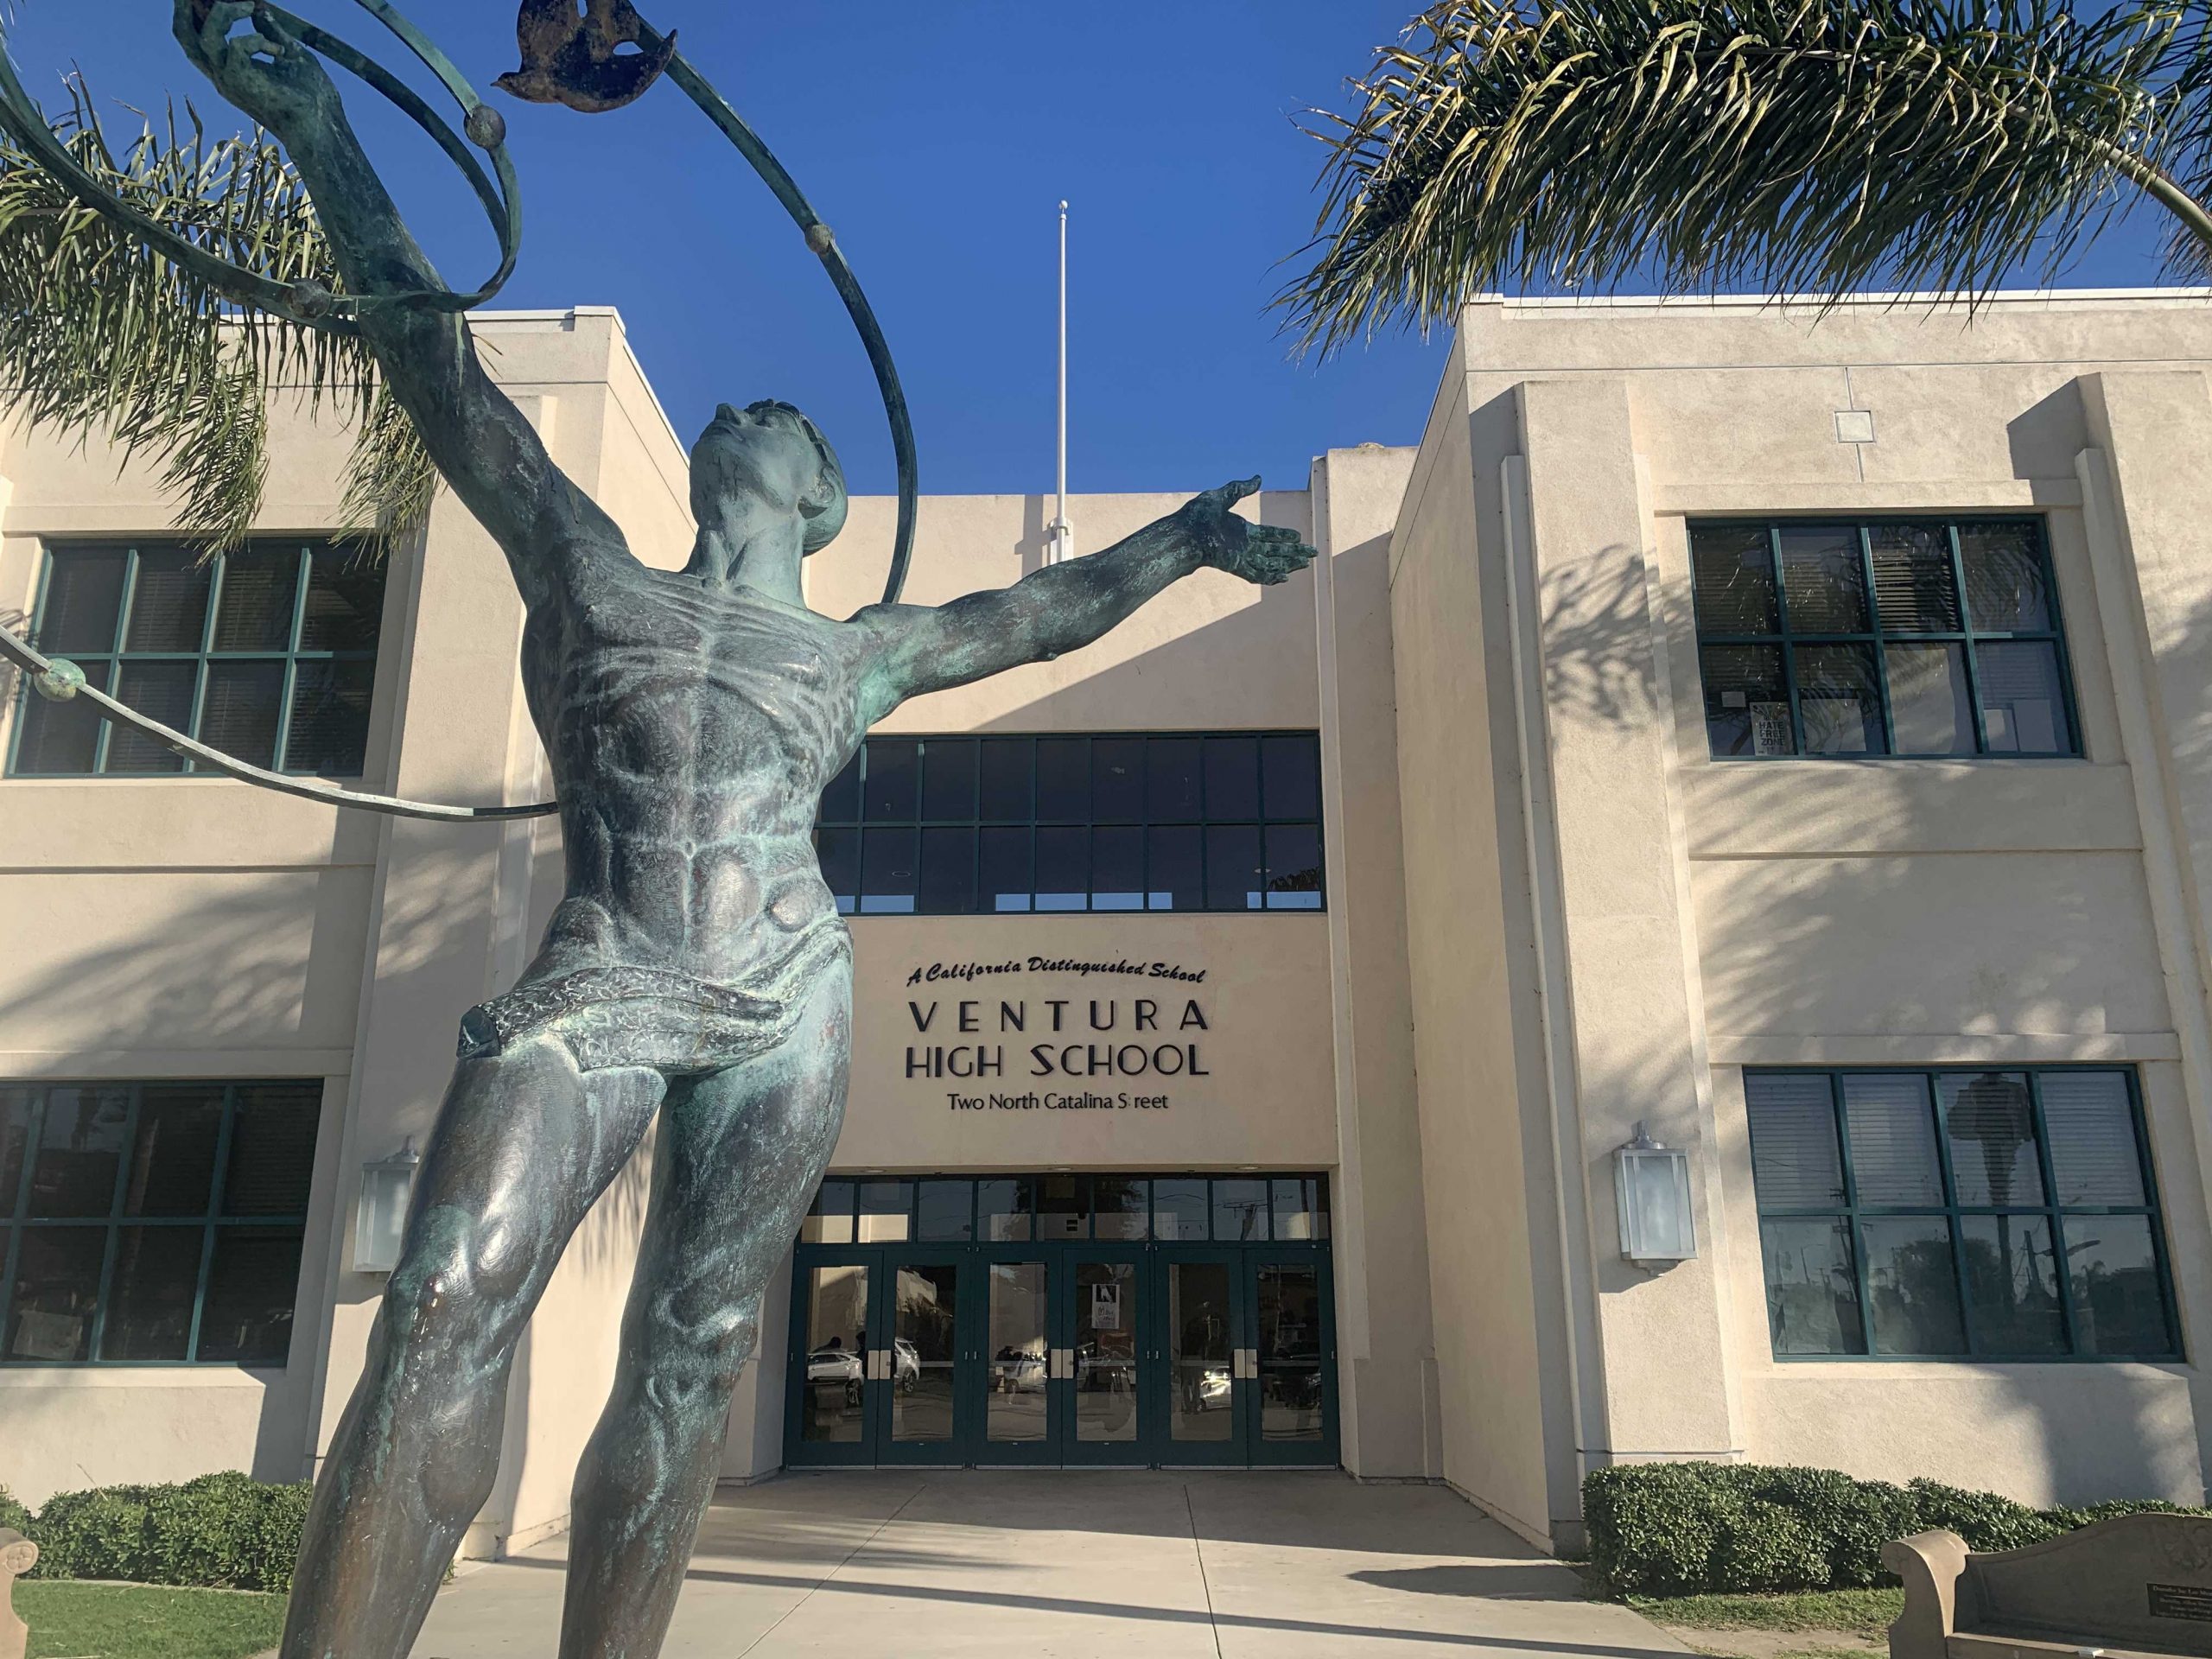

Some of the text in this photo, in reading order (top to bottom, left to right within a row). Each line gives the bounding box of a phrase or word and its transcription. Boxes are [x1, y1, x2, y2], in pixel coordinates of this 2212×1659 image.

[906, 956, 1206, 987] A California Distinguished School
[908, 1000, 1208, 1032] VENTURA
[906, 1044, 1210, 1078] HIGH SCHOOL
[947, 1091, 1169, 1110] Two North Catalina Sreet
